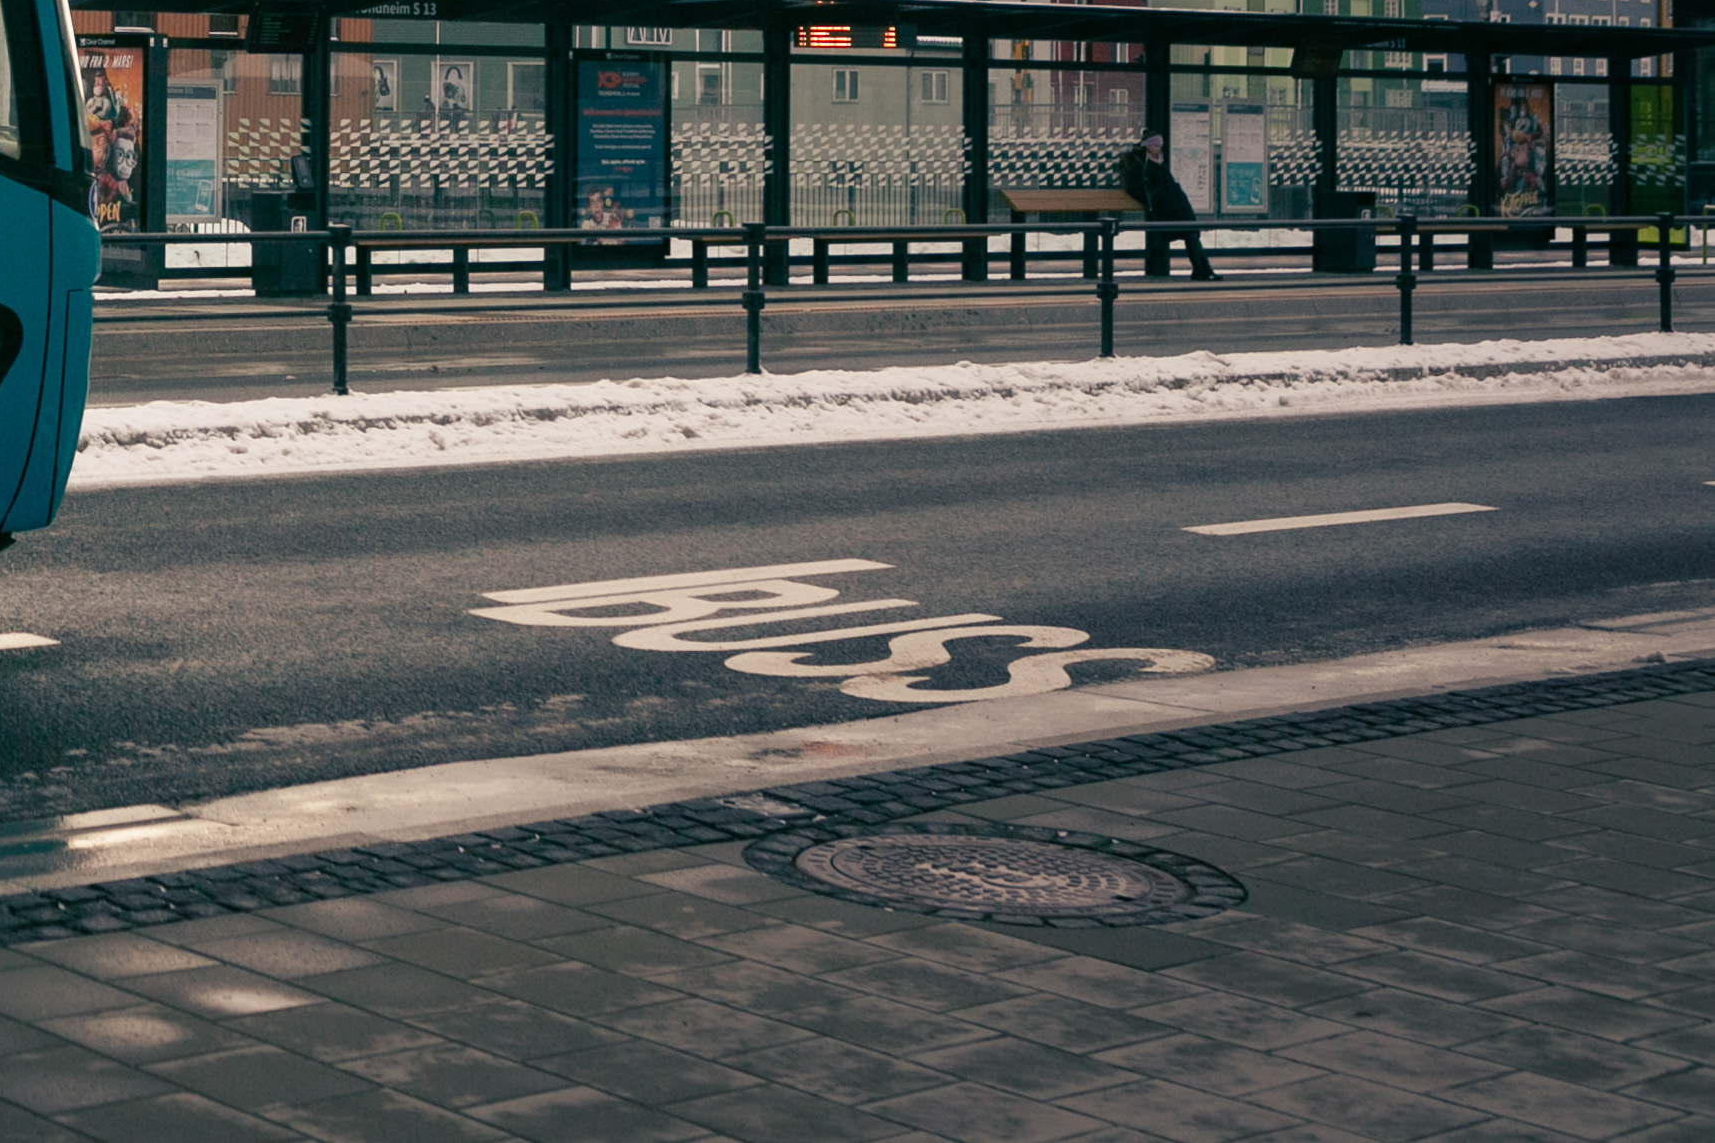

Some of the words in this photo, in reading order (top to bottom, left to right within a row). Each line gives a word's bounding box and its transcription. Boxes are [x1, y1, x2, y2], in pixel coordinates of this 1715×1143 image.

[413, 2, 421, 16] S
[423, 3, 437, 16] 13
[465, 558, 1216, 703] BUS
